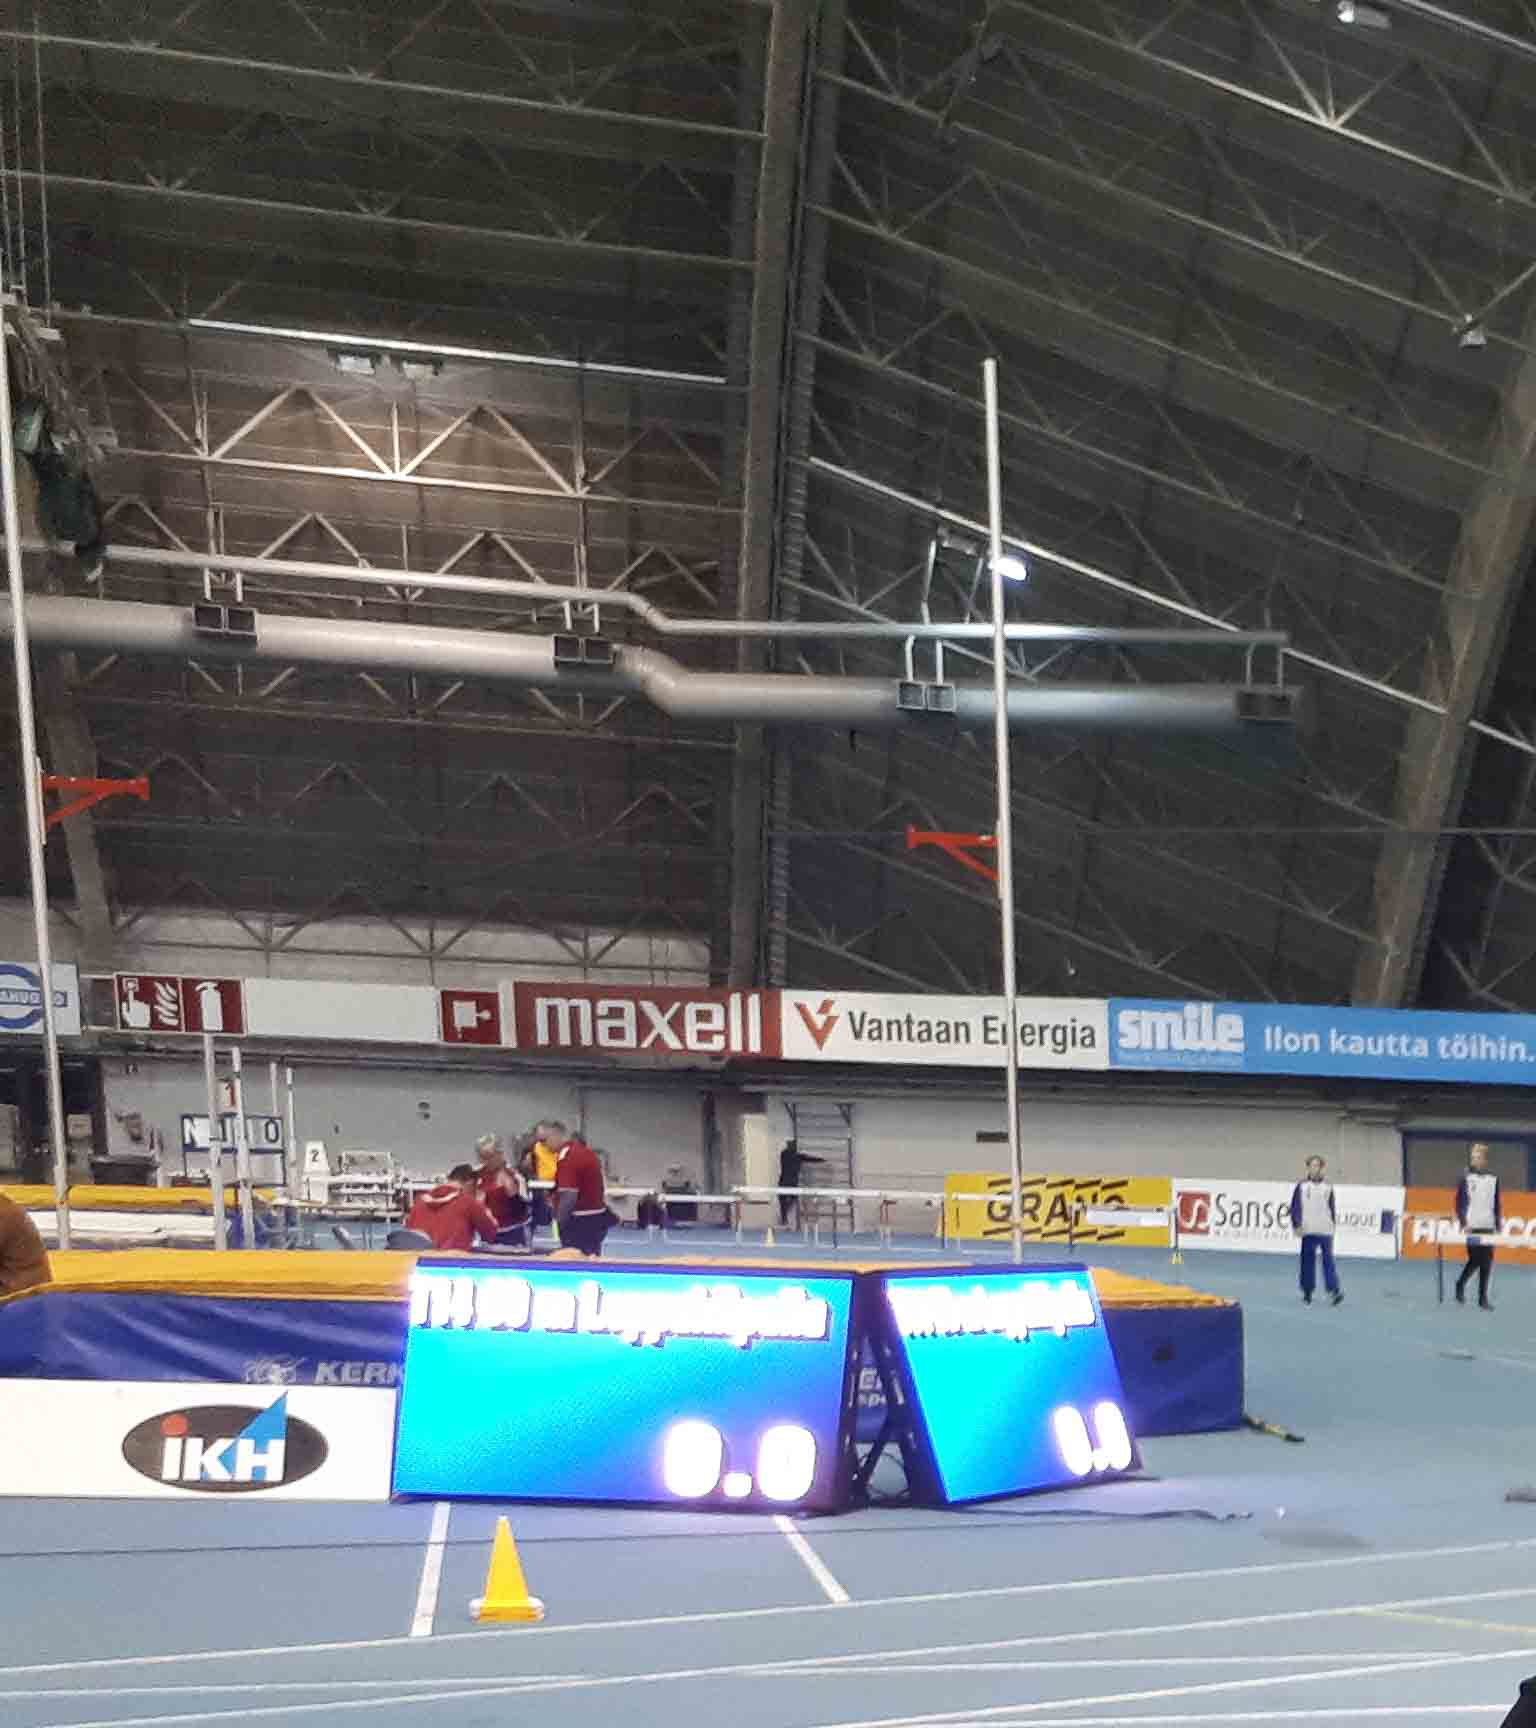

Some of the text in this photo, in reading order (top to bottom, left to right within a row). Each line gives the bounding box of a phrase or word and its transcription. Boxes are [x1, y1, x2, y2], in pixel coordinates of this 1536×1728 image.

[534, 991, 762, 1053] maxell
[847, 1008, 971, 1045] Vantaan
[1118, 1001, 1245, 1054] smile
[1263, 1024, 1320, 1053] Ilon
[1329, 1027, 1429, 1058] kautta
